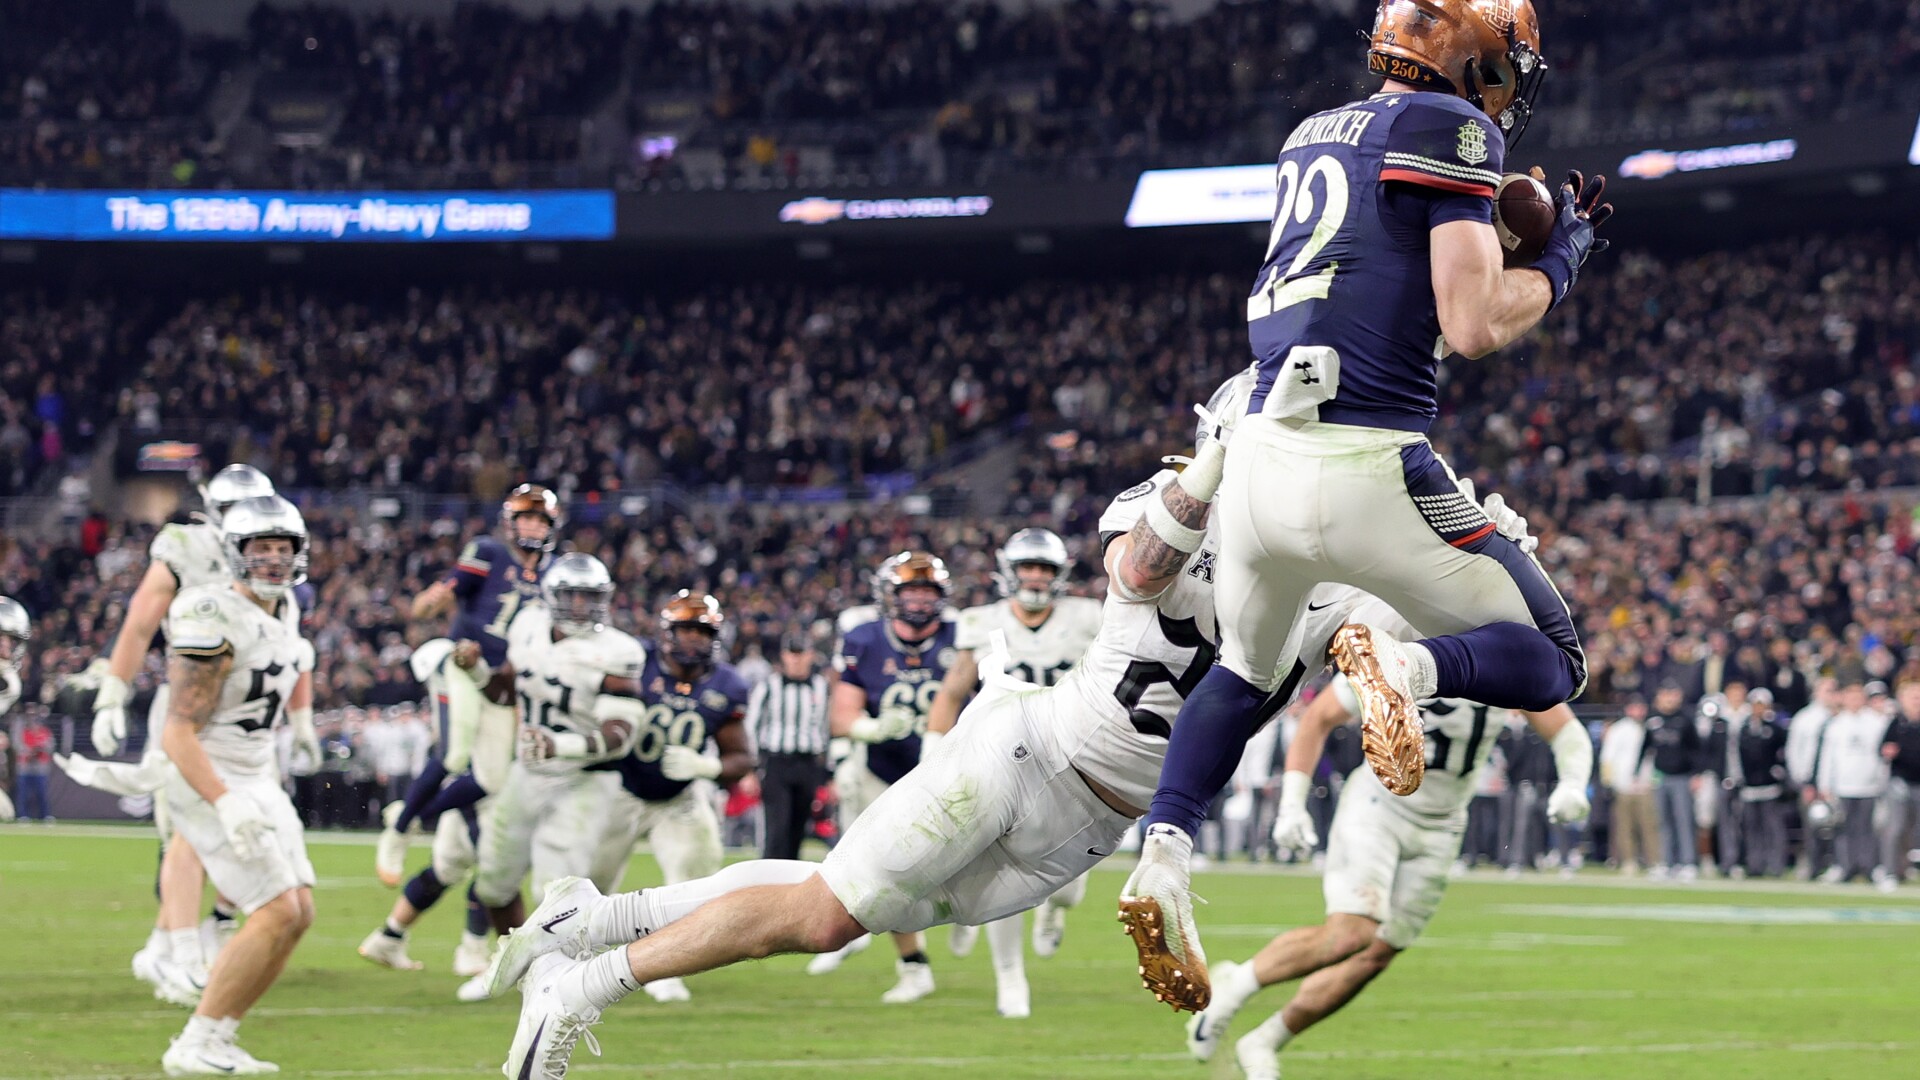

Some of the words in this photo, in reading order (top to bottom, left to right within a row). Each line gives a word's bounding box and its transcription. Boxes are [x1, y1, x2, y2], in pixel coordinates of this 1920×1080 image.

[1383, 30, 1396, 46] 22
[1390, 59, 1419, 81] 250
[106, 196, 167, 231] The
[261, 198, 441, 238] Army-Navy
[443, 198, 531, 231] Game
[1246, 154, 1348, 322] 22
[632, 703, 706, 764] 60
